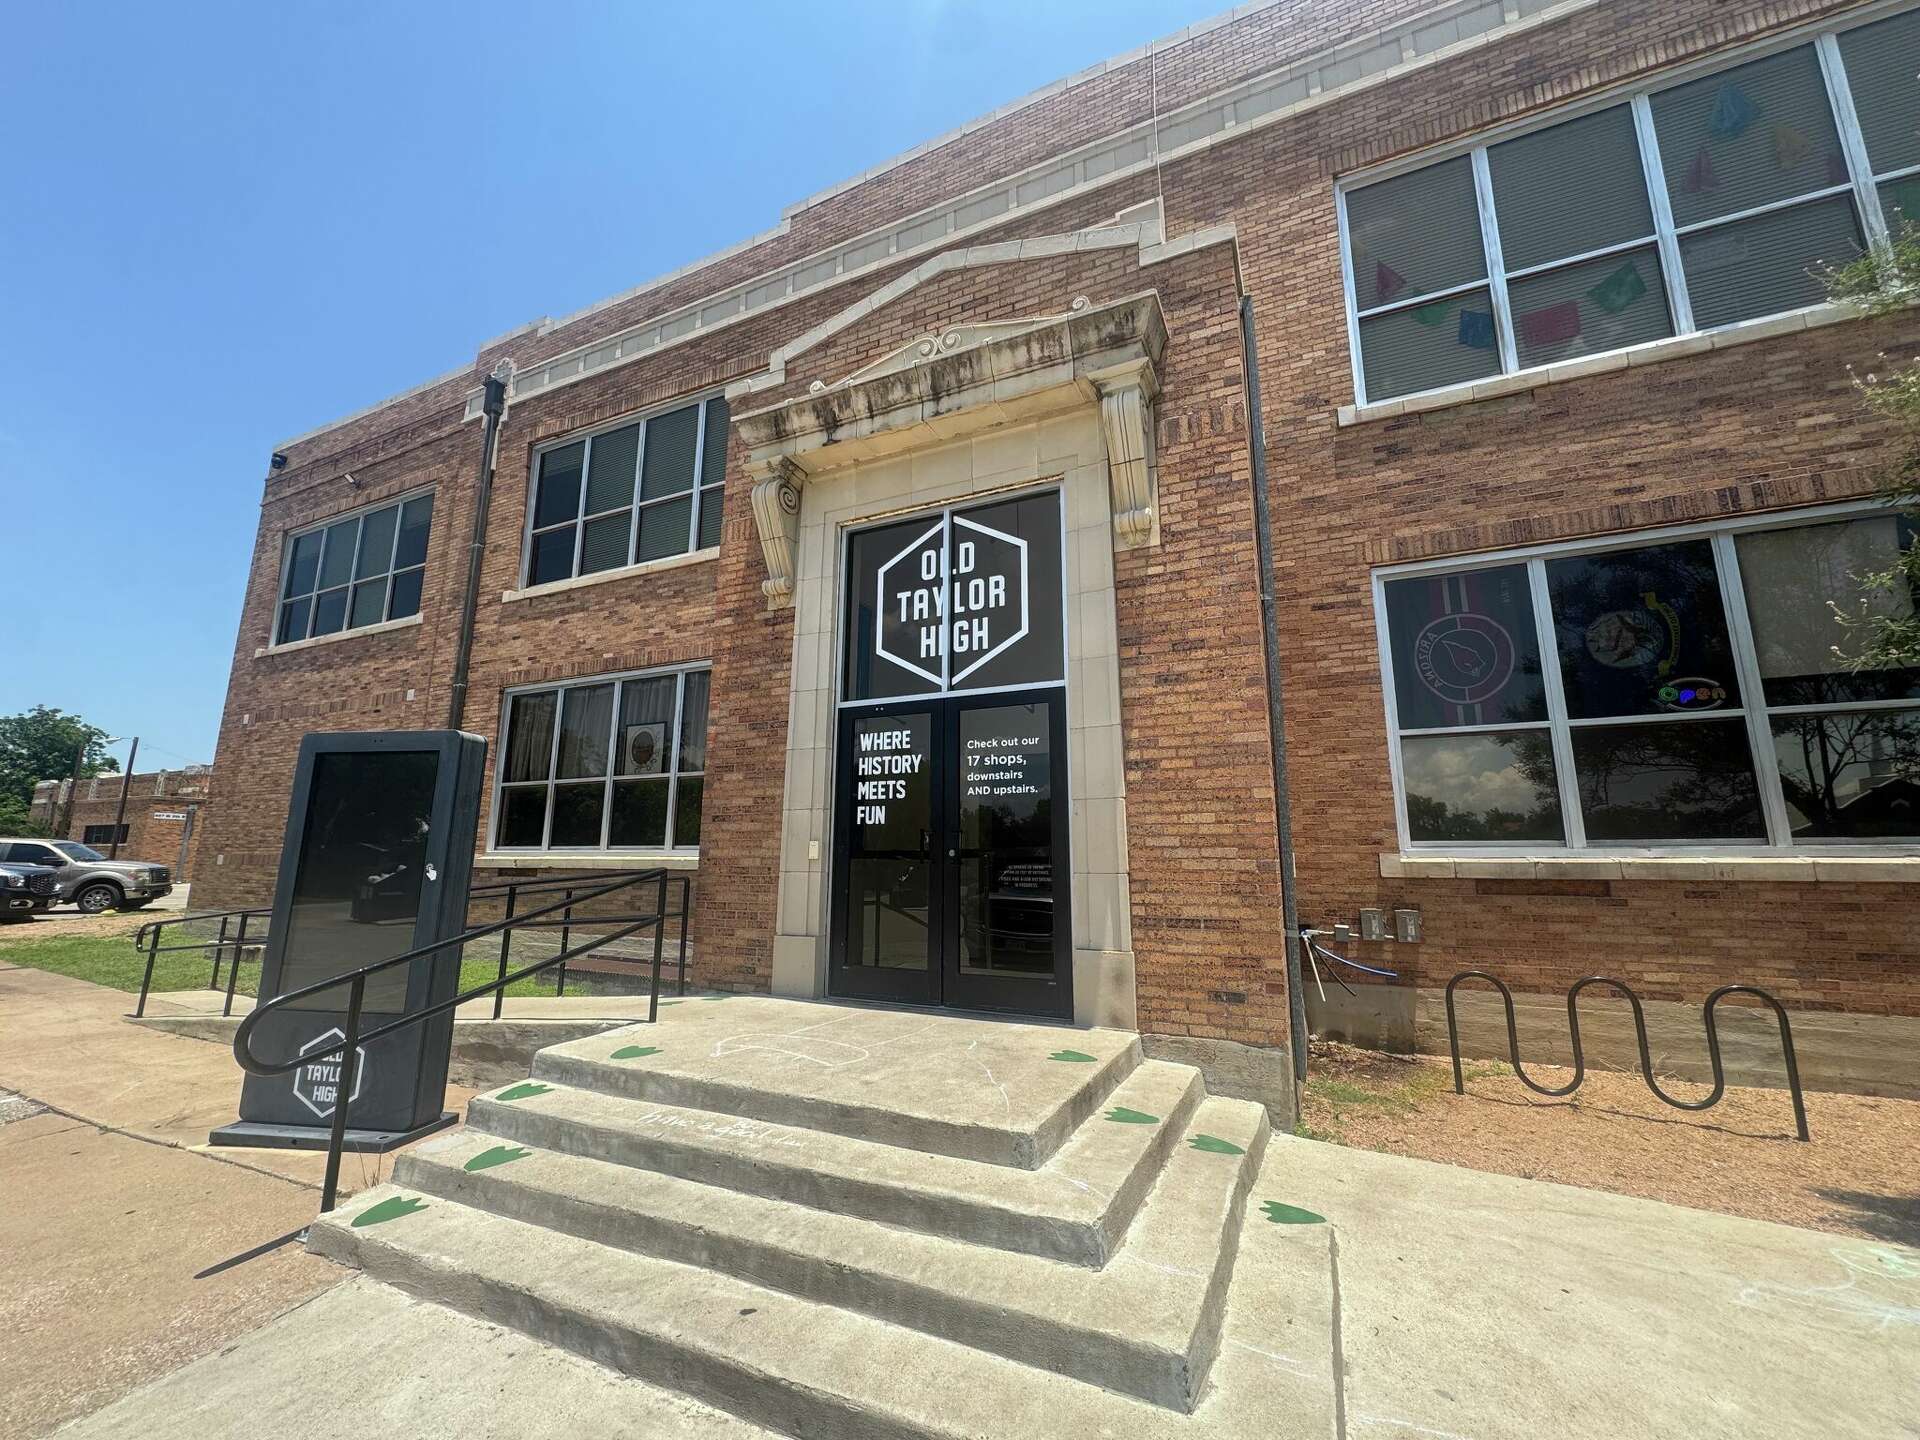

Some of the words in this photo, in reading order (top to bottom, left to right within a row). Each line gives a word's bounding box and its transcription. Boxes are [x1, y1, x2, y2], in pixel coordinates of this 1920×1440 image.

[897, 574, 1006, 622] TAYLOR
[920, 616, 989, 658] HIGH
[860, 730, 911, 752] WHERE
[967, 738, 998, 749] Check
[1001, 737, 1018, 747] out
[1021, 737, 1040, 745] our
[858, 754, 922, 776] HISTORY
[967, 755, 980, 767] 17
[984, 753, 1027, 767] shops,
[967, 770, 1023, 781] downstairs
[857, 780, 906, 801] MEETS
[967, 786, 991, 796] AND
[993, 784, 1038, 796] upstairs.
[856, 806, 886, 825] FUN
[307, 1065, 341, 1082] TAYL
